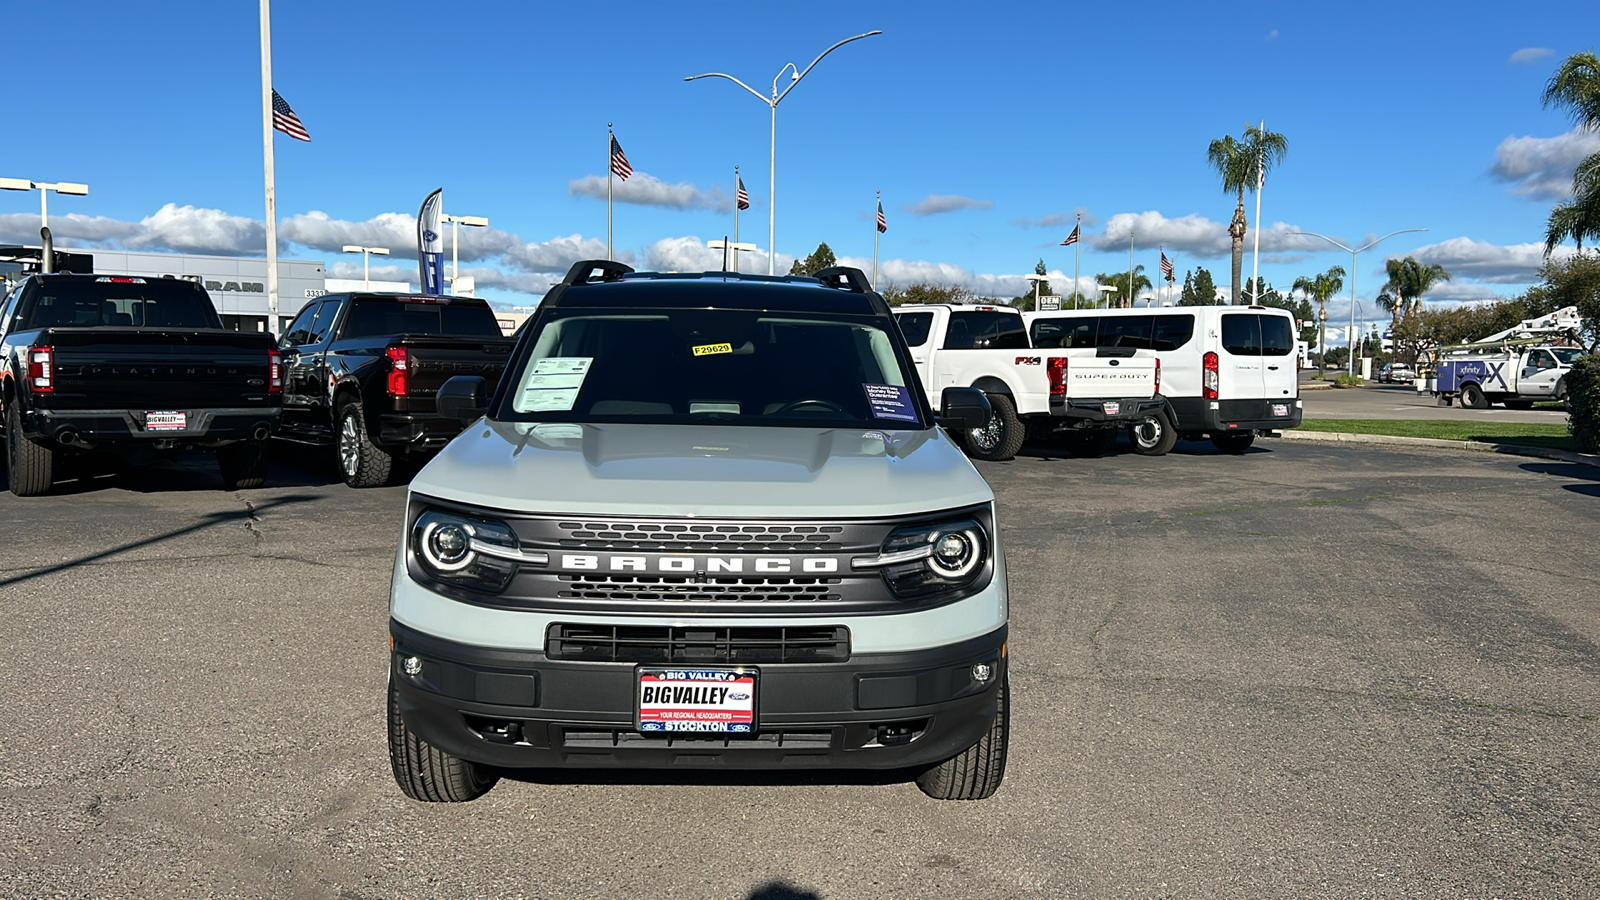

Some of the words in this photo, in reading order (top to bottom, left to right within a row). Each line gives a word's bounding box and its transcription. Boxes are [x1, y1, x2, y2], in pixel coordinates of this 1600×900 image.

[205, 281, 264, 293] RAM
[694, 345, 730, 354] F29629
[1015, 357, 1041, 365] FX4
[1460, 366, 1480, 374] xfinity
[562, 554, 838, 572] BRONCO
[689, 672, 729, 680] VALLEY
[731, 692, 748, 700] Ford
[664, 722, 728, 732] STOCKTON
